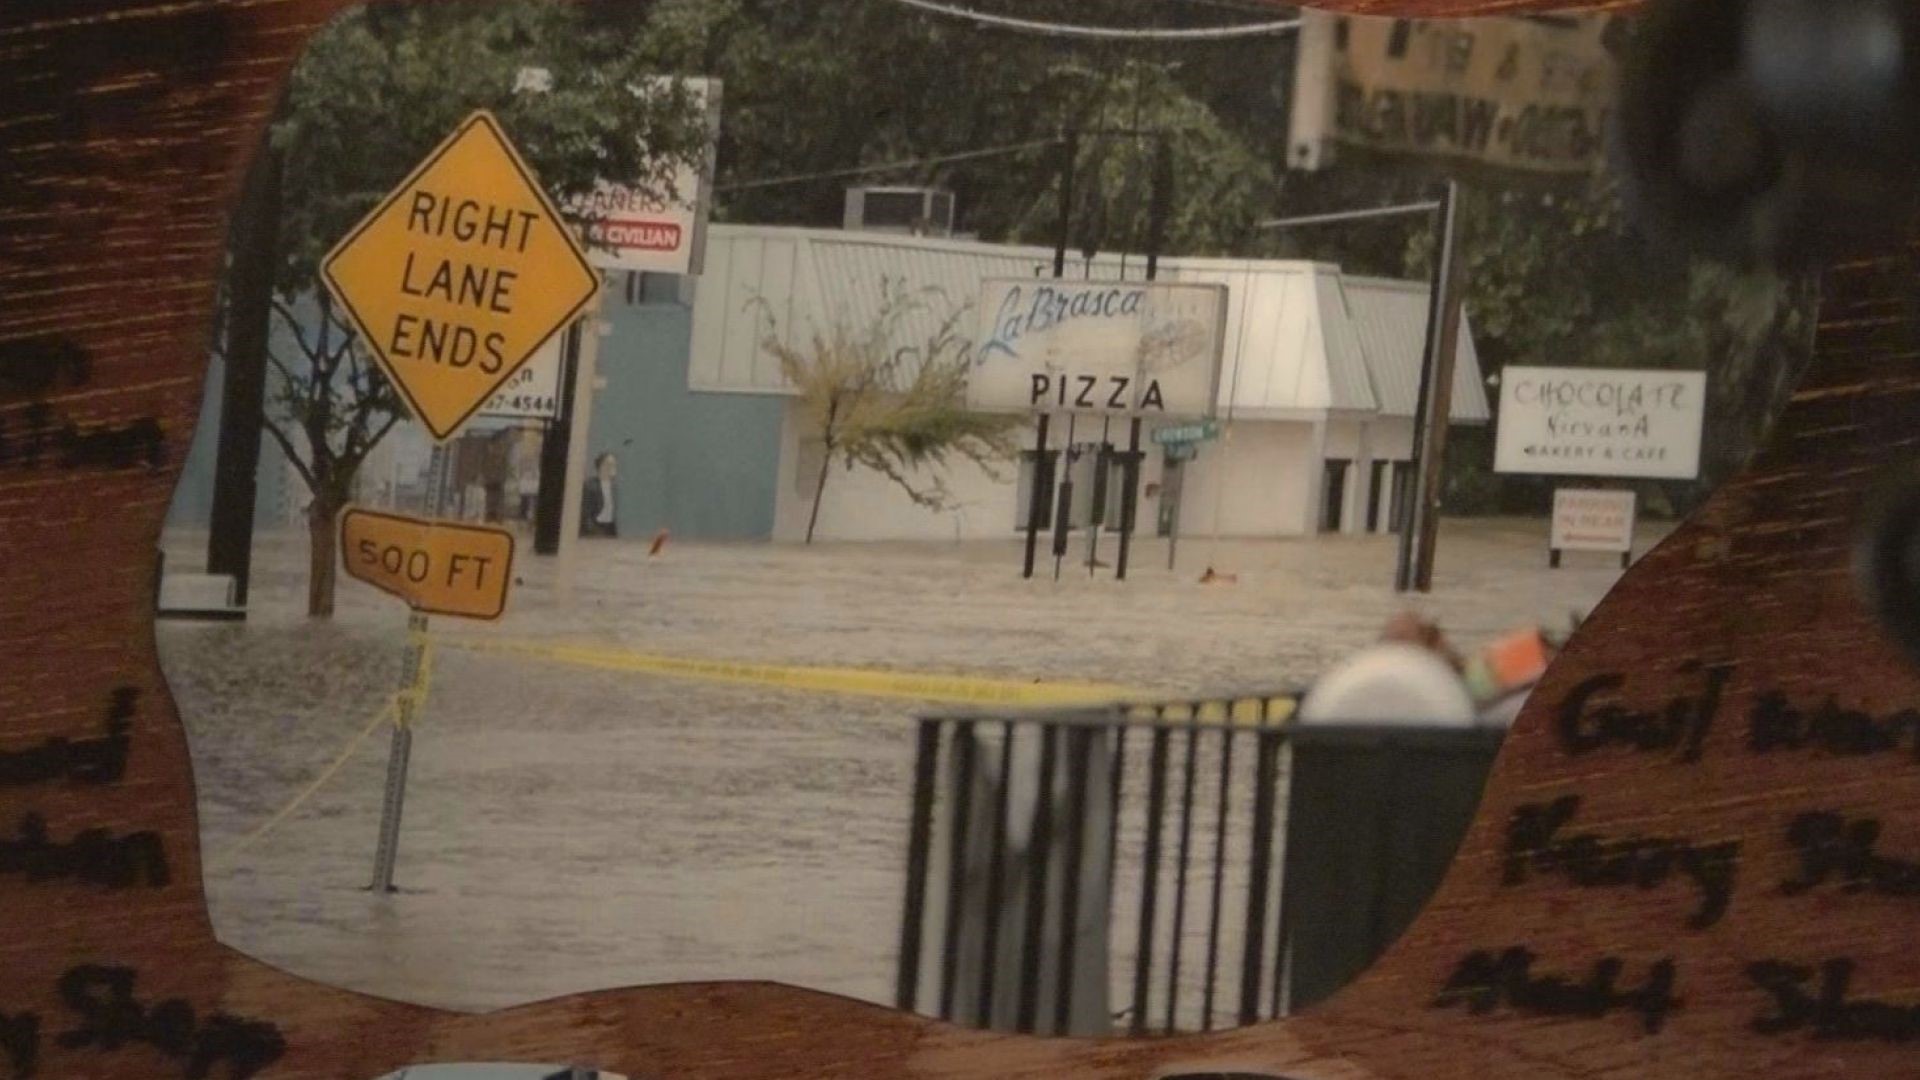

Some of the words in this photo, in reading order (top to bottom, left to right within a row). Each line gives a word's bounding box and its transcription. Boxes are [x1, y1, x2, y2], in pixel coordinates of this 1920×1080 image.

[407, 191, 539, 253] RIGHT
[606, 226, 678, 247] CIVILIAN
[402, 252, 518, 314] LANE
[390, 313, 507, 376] ENDS
[1031, 373, 1165, 412] PIZZA
[1514, 381, 1685, 417] CHOCOLATE
[1528, 444, 1595, 459] BAKERY
[359, 539, 430, 583] 500
[446, 553, 492, 591] FT
